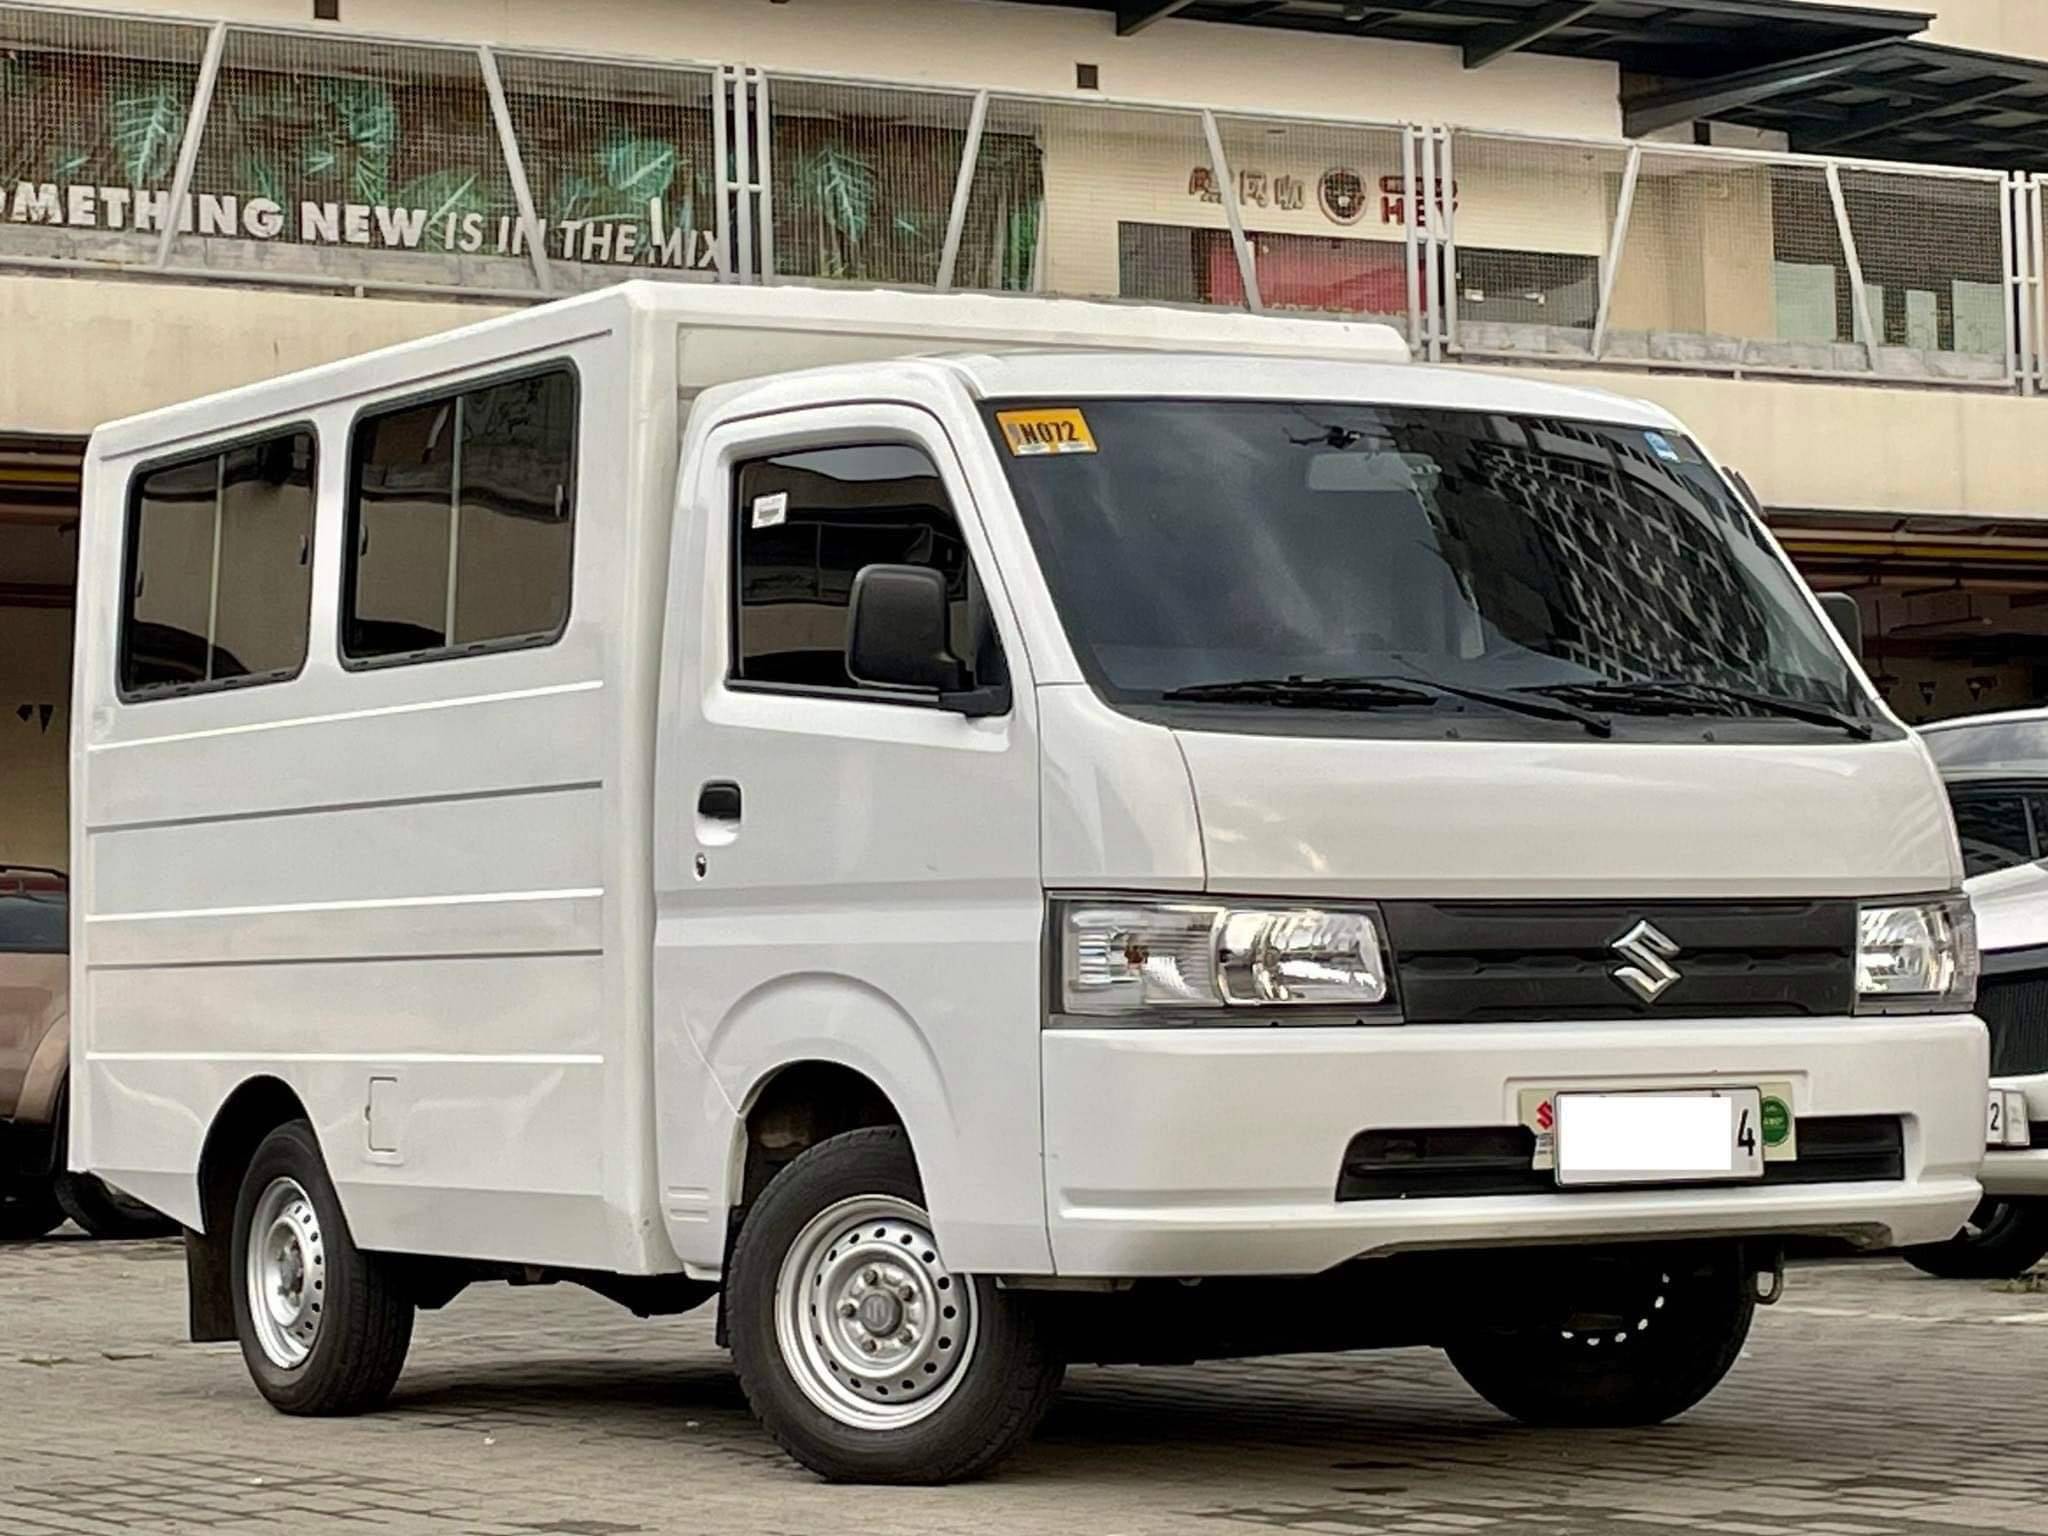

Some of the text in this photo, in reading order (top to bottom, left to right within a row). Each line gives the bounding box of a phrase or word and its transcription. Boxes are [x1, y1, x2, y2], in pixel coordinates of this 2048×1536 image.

[0, 181, 284, 238] METHING
[301, 201, 428, 246] NEW
[445, 212, 484, 252] IS
[560, 220, 639, 262] THE
[1737, 1109, 1755, 1156] 4
[1990, 1102, 2000, 1131] 2
